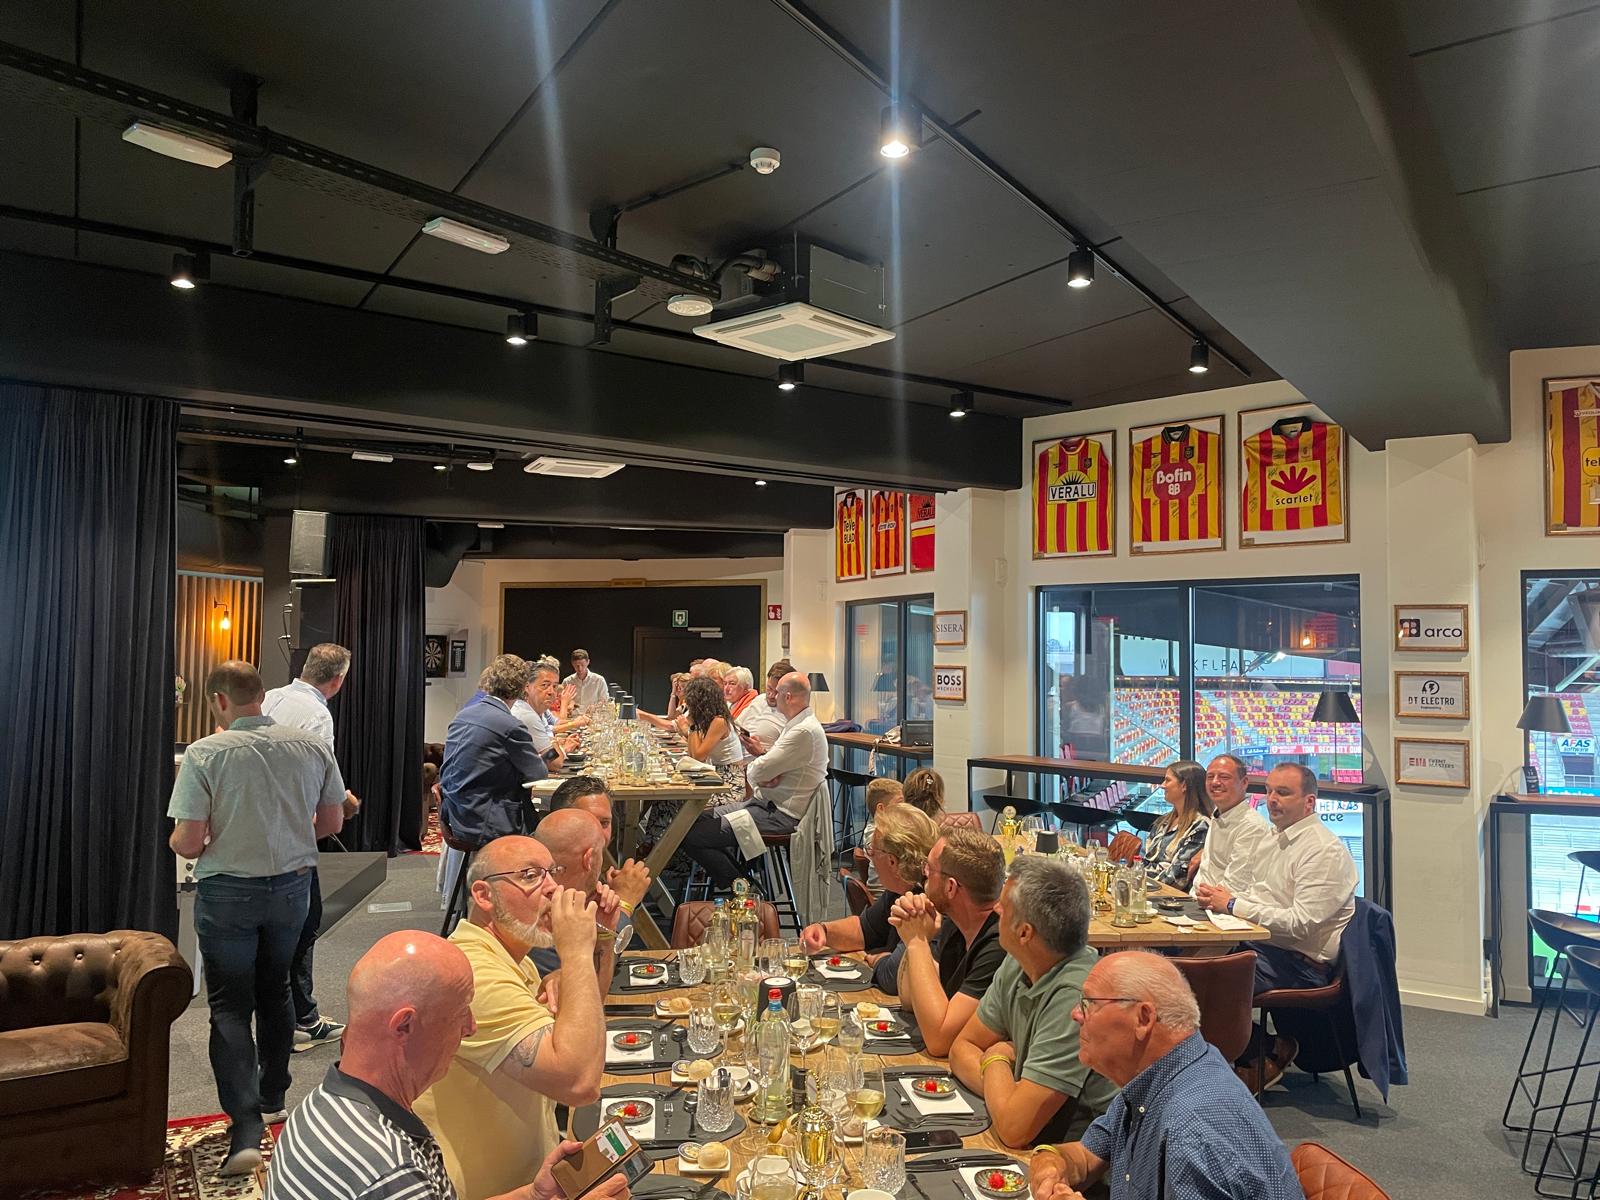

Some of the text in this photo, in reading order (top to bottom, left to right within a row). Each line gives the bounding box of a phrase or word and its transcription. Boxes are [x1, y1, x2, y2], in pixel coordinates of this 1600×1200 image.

[1156, 468, 1192, 485] Bofin
[1050, 484, 1095, 500] VERALU
[1275, 494, 1313, 506] scarlet
[936, 623, 964, 633] SISERA
[937, 674, 962, 687] BOSS
[1421, 696, 1455, 706] ELECTRO
[1561, 738, 1591, 748] AFAS
